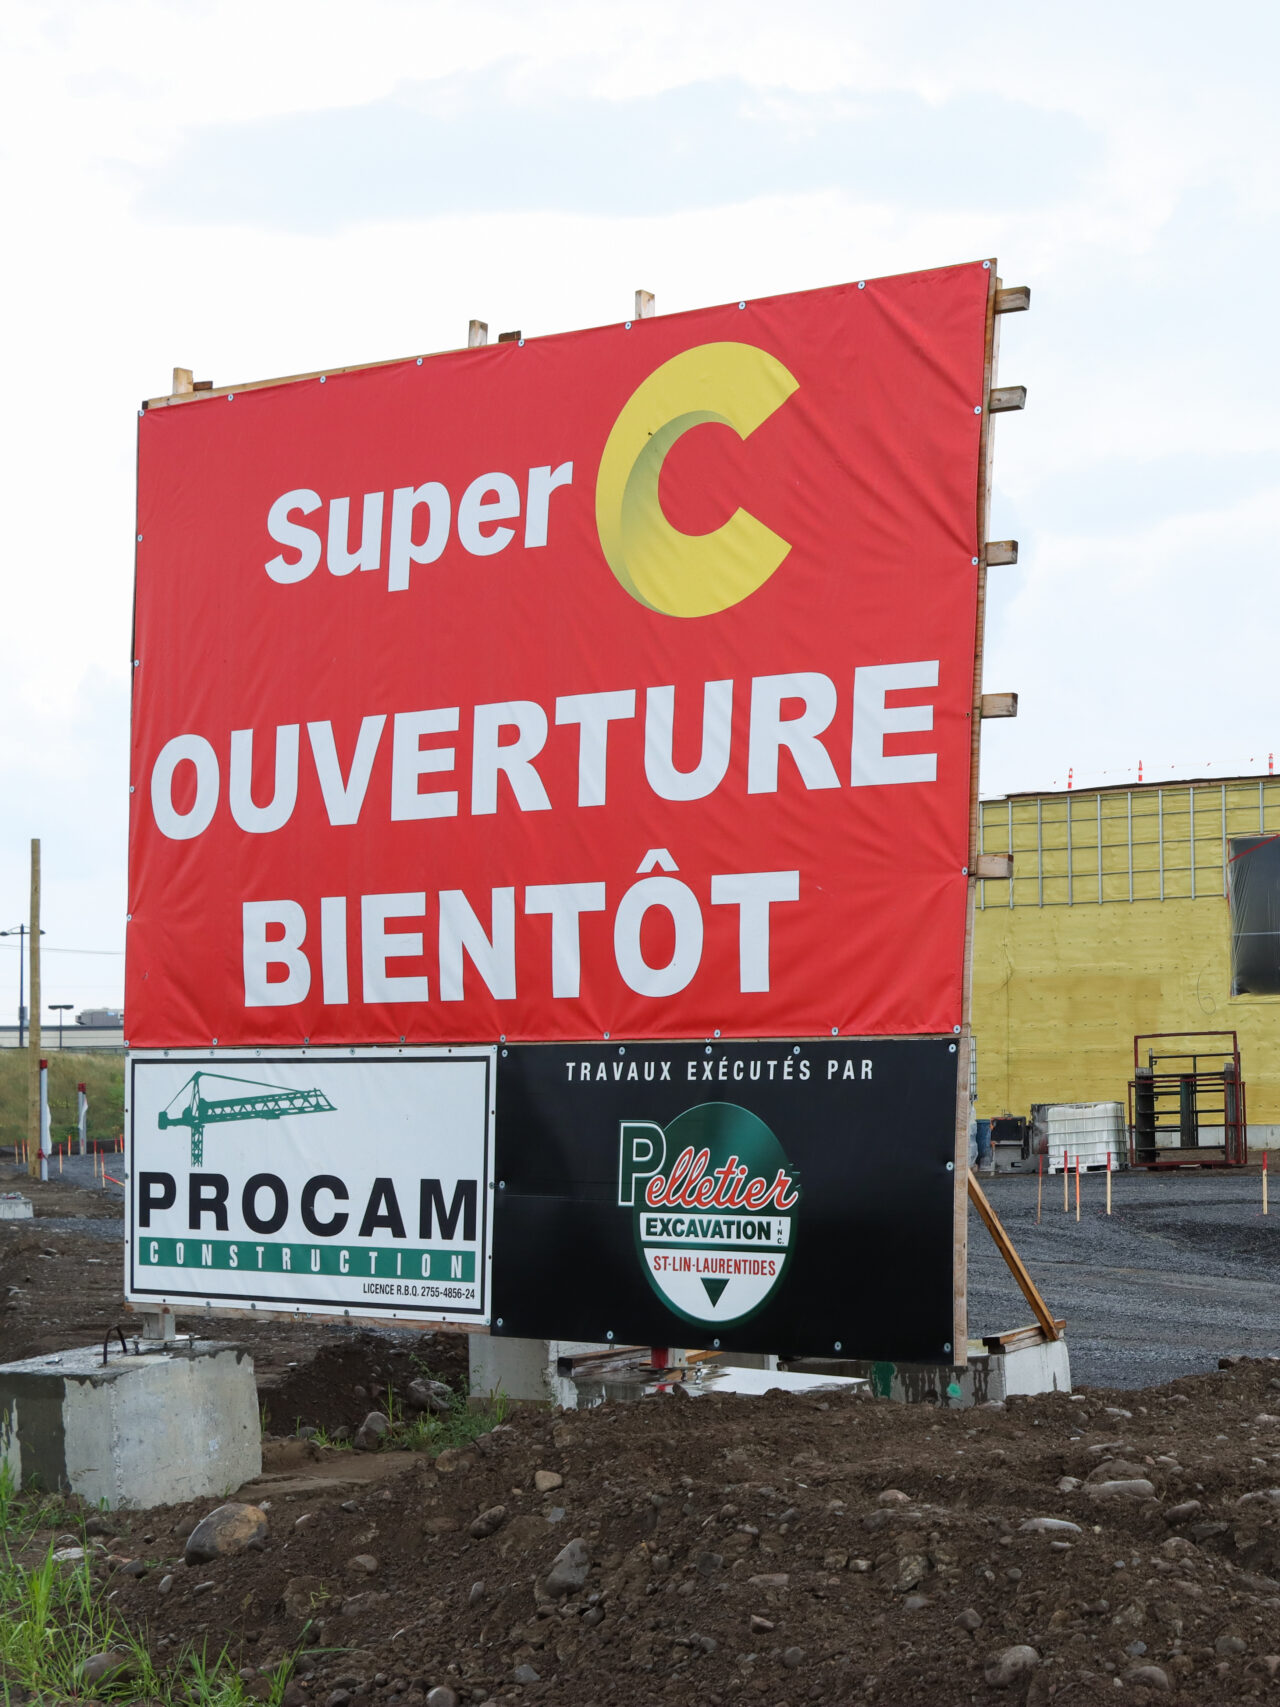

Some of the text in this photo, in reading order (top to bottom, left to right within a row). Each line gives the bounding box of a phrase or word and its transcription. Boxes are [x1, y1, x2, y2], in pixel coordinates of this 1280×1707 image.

[264, 341, 800, 618] Super C
[150, 659, 940, 841] OUVERTURE
[242, 848, 800, 1008] BIENTÔT
[566, 1056, 873, 1081] TRAVAUX EXÉCUTÉS PAR
[618, 1120, 799, 1211] Pelletier
[138, 1171, 478, 1241] PROCAM
[645, 1217, 785, 1245] EXCAVATION INC.
[149, 1240, 463, 1279] CONSTRUCTION
[653, 1255, 776, 1276] ST-LIN-LAURENTIDES
[363, 1283, 475, 1299] LICENCE R.B.Q. 2755-4856-24
